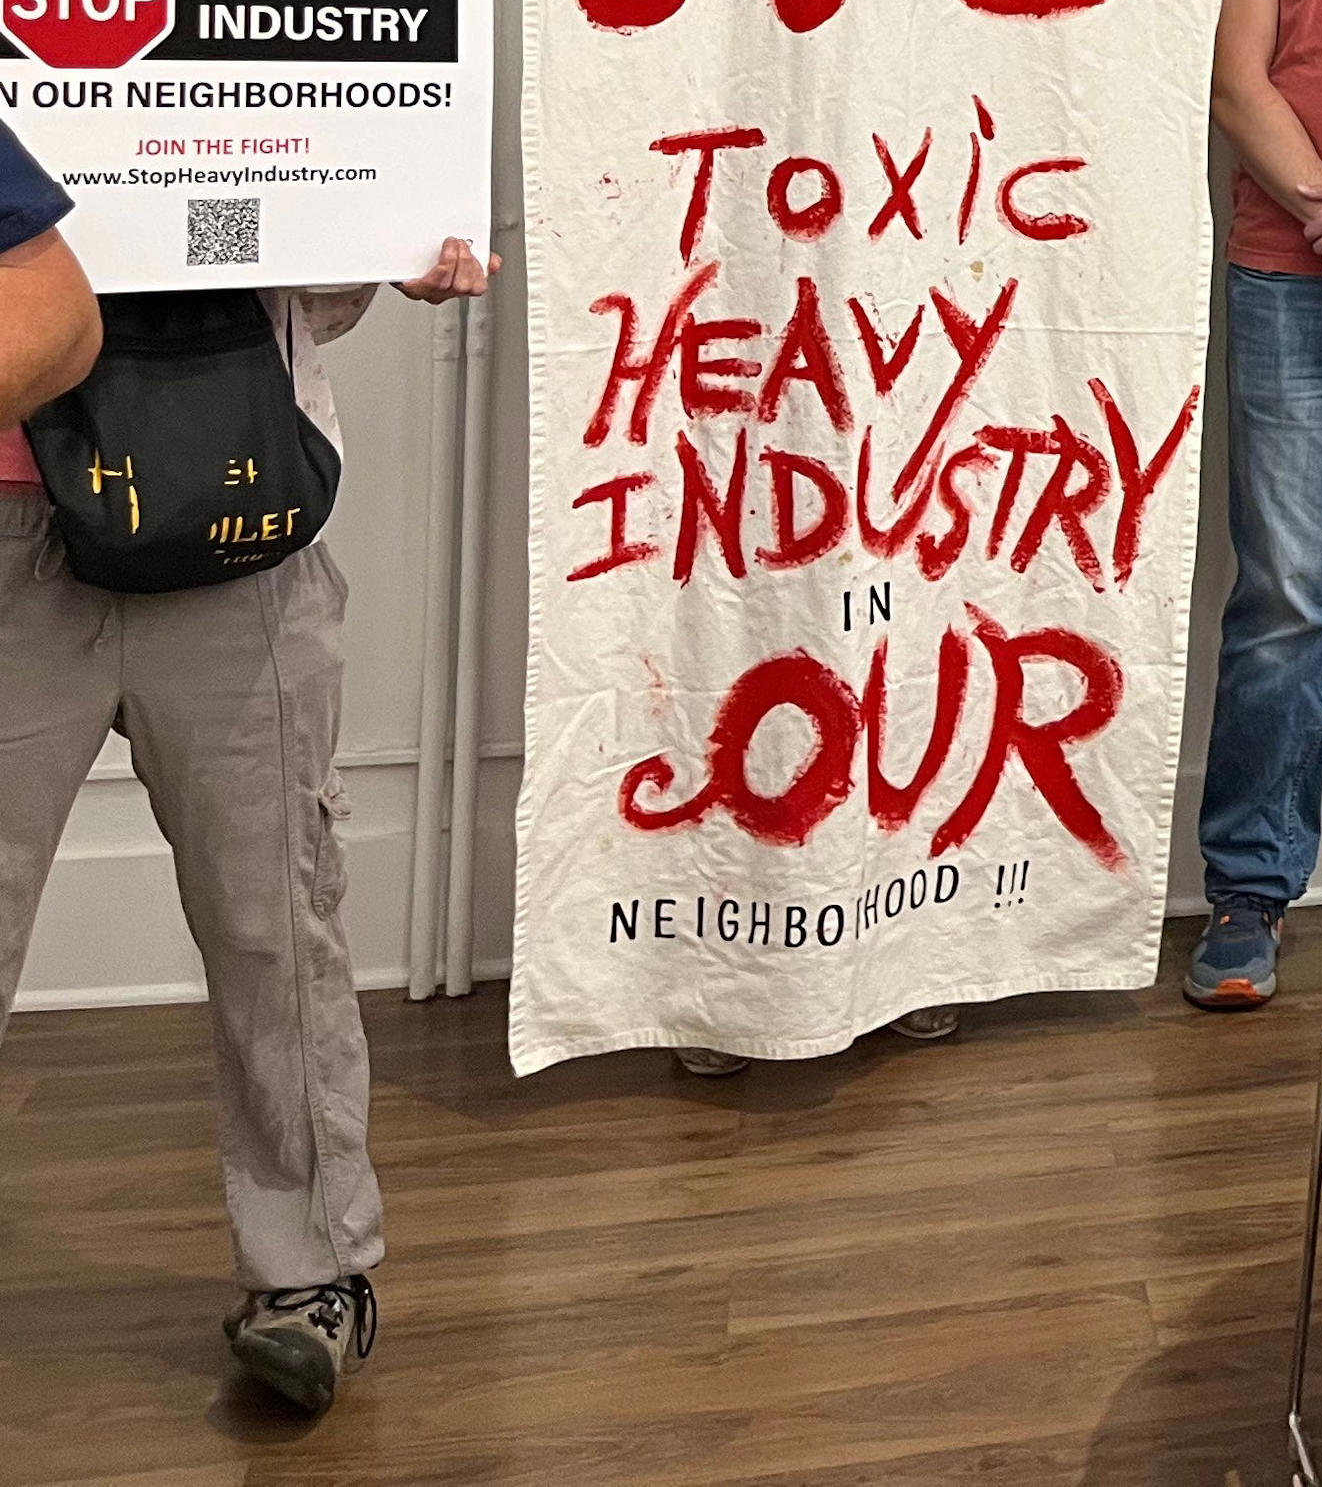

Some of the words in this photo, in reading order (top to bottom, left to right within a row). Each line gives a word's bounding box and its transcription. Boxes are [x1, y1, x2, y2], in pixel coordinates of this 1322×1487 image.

[199, 4, 429, 42] INDUSTRY
[32, 81, 113, 108] OUR
[127, 80, 451, 109] NEIGHBORHOODS!
[136, 139, 186, 156] JOIN
[192, 139, 234, 155] THE
[240, 138, 311, 155] FIGHT!
[62, 165, 377, 189] www.StopHeavyIndustry.com
[583, 261, 1018, 499] HEAVY
[566, 377, 1200, 591] INDUSTRY
[843, 581, 891, 632] IN
[618, 600, 1130, 873] OUR
